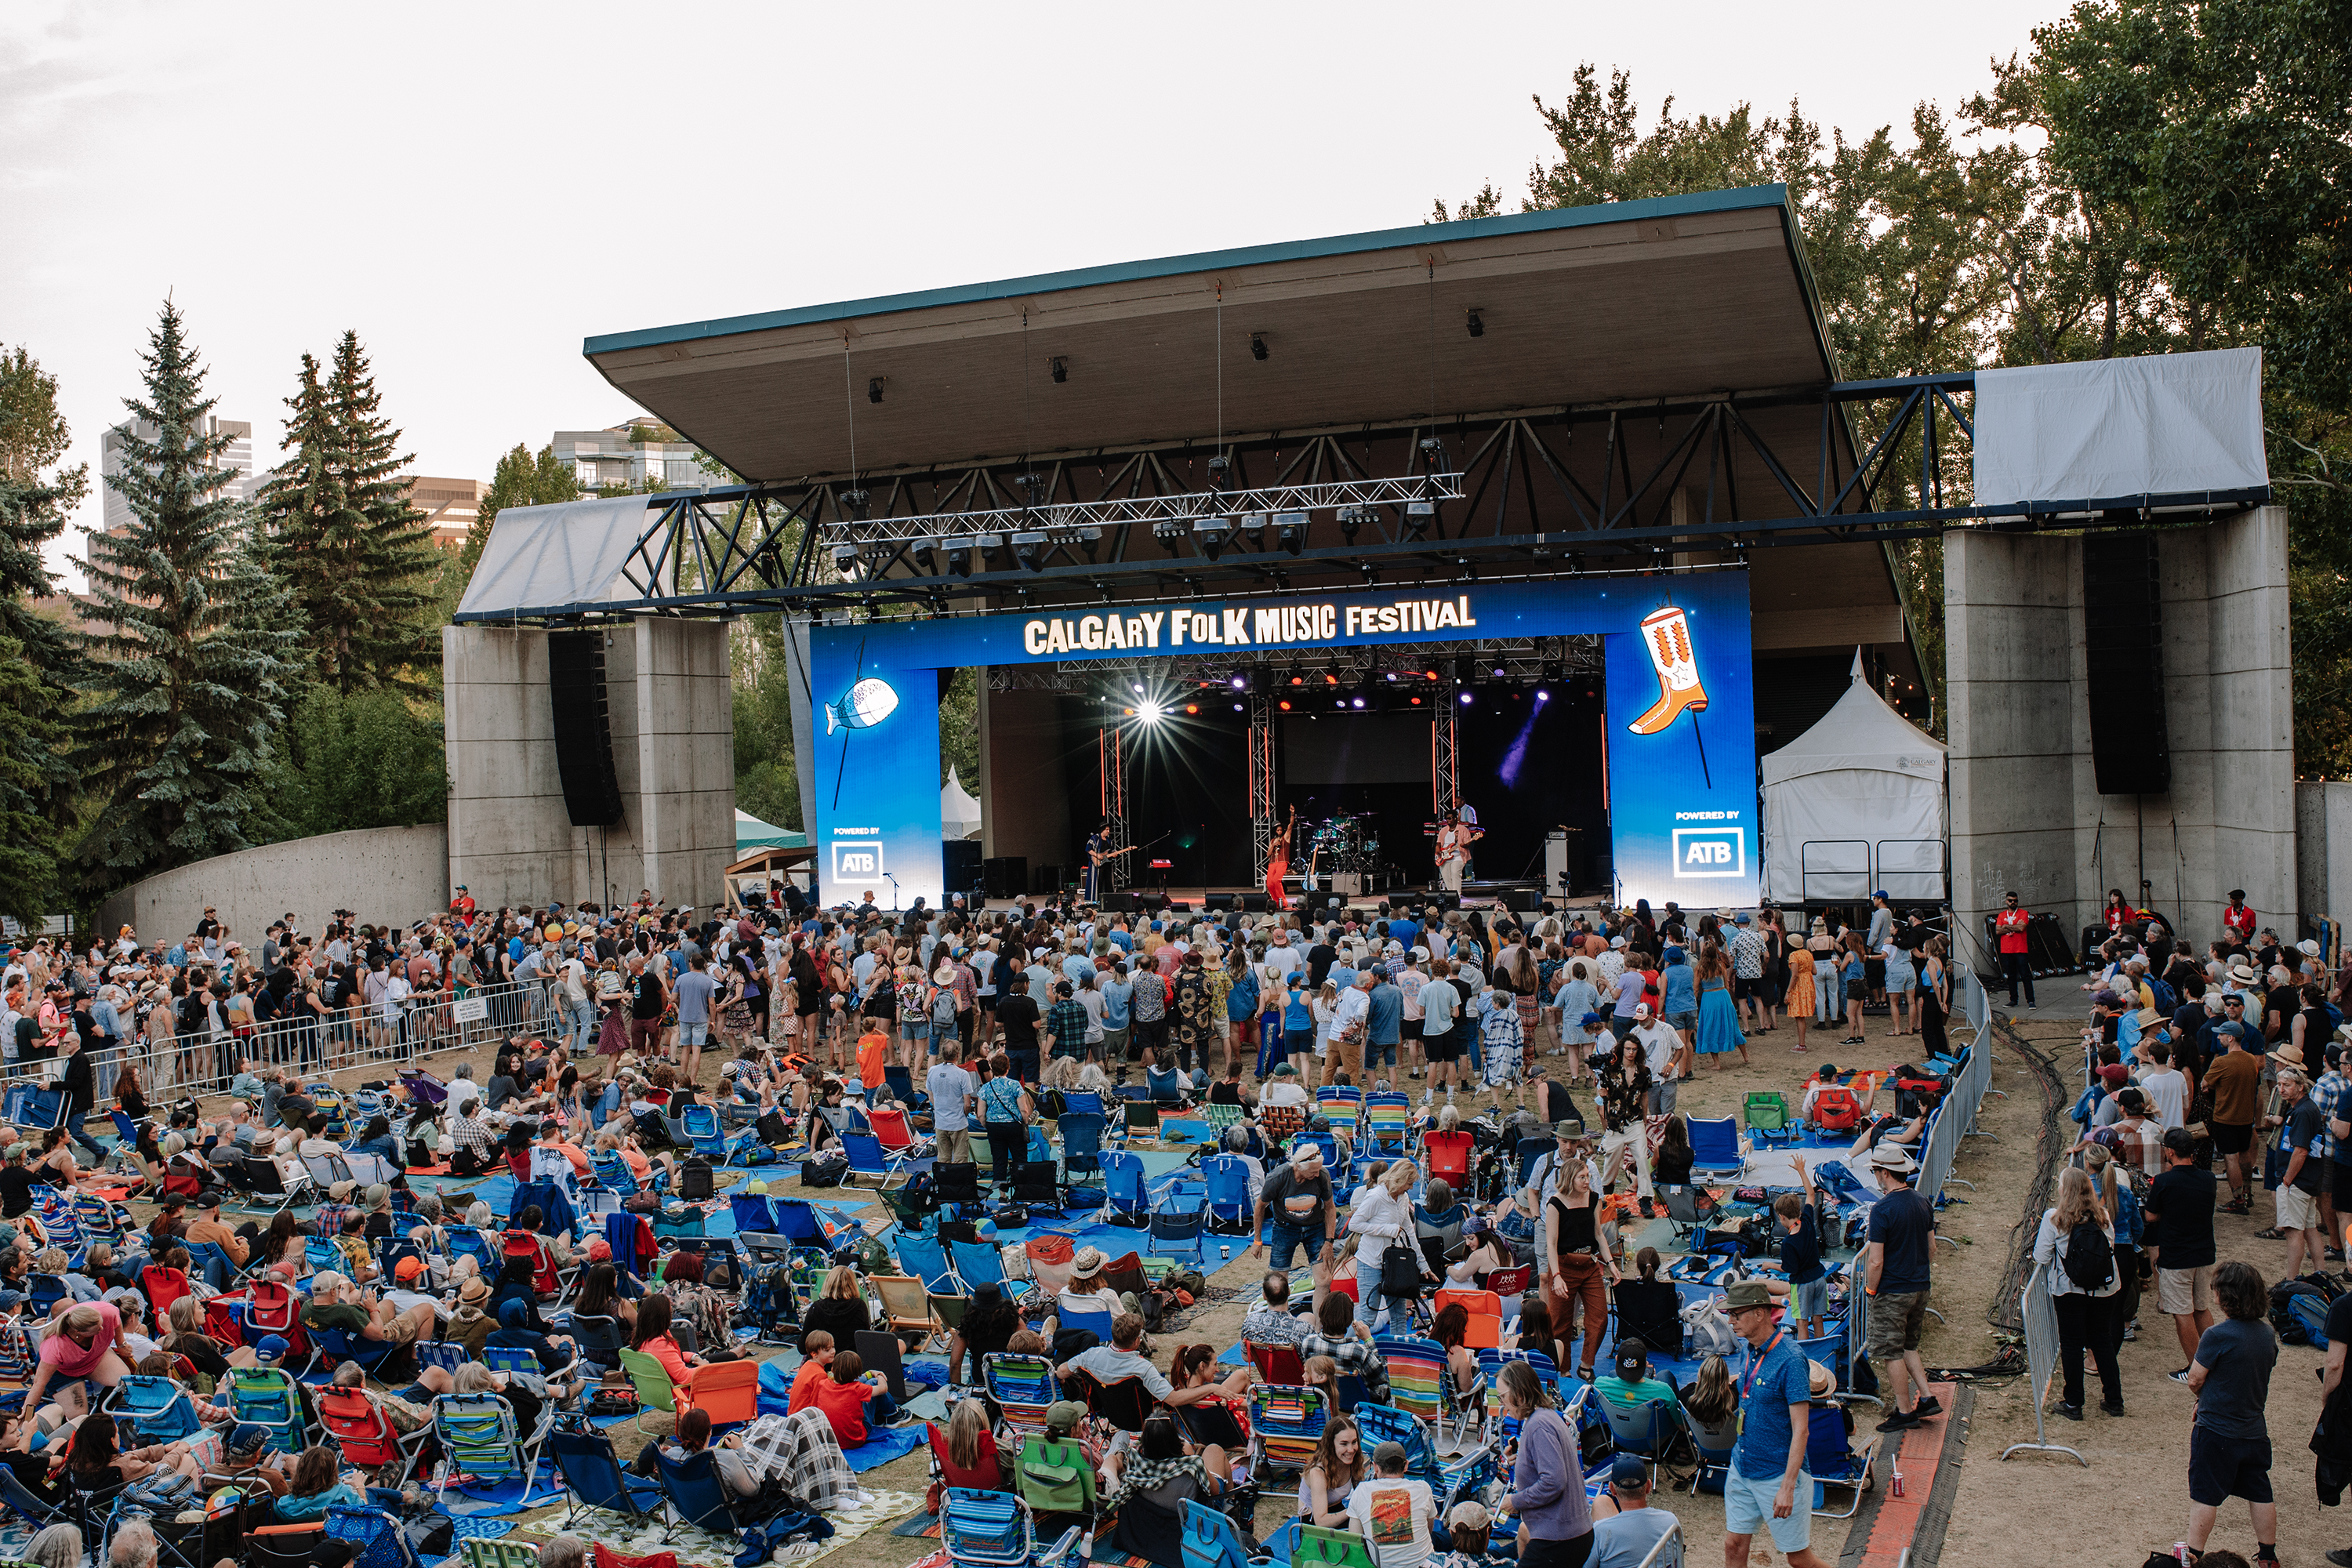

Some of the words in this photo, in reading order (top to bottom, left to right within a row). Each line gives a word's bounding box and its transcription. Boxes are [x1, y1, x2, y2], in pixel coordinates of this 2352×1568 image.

[1024, 612, 1164, 655] CALGARY
[1171, 608, 1251, 646] FOLK
[1254, 606, 1337, 644] MUSIC
[1345, 596, 1475, 637] FESTIVAL
[1676, 811, 1725, 821] POWERED
[1726, 811, 1740, 819] BY
[833, 827, 869, 836] POWERED
[1686, 841, 1731, 863] ATB
[842, 854, 874, 873] ATB
[858, 1041, 873, 1051] CREW
